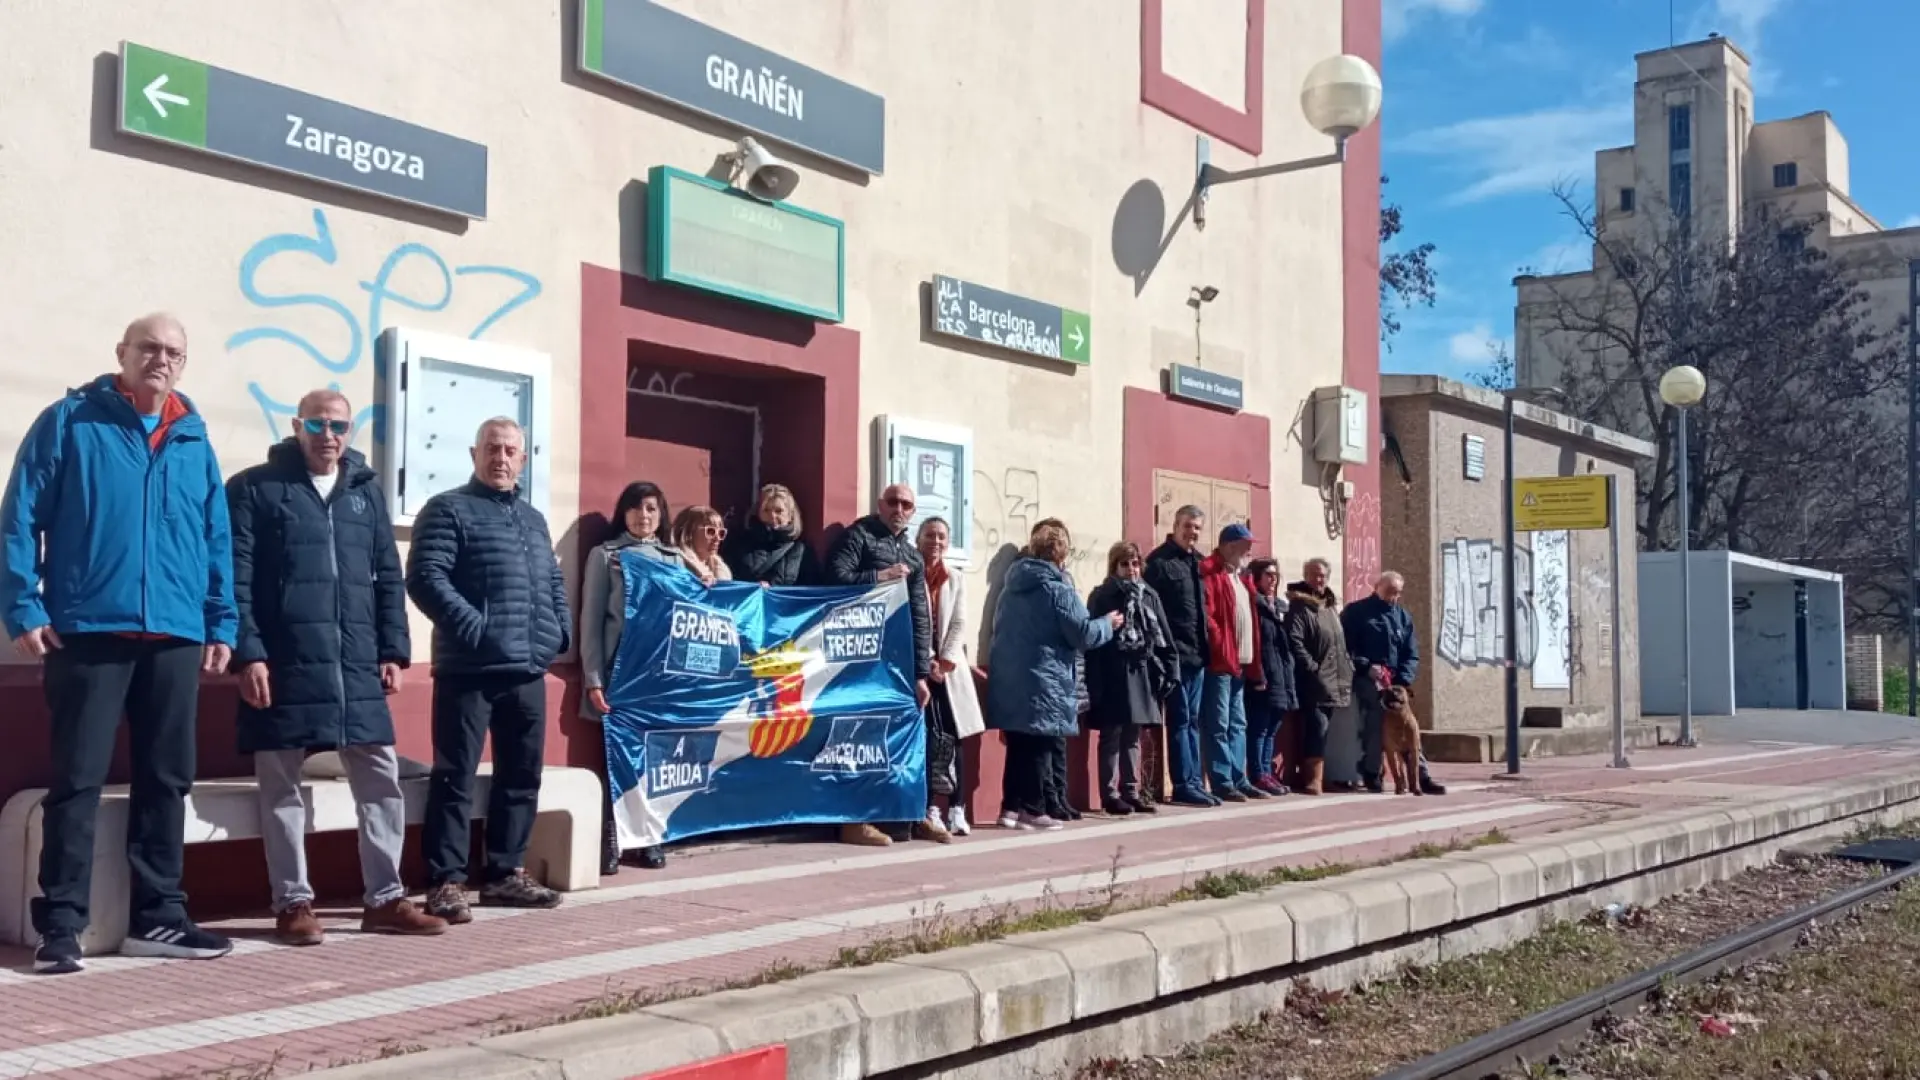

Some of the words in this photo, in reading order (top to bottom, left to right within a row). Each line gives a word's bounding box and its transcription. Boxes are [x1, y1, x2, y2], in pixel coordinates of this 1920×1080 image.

[706, 54, 803, 120] GRAÑÉN
[285, 114, 424, 180] Zaragoza
[969, 300, 1035, 337] Barcelona
[826, 633, 879, 657] TRENES
[672, 735, 685, 757] A
[652, 760, 702, 792] LÉRIDA
